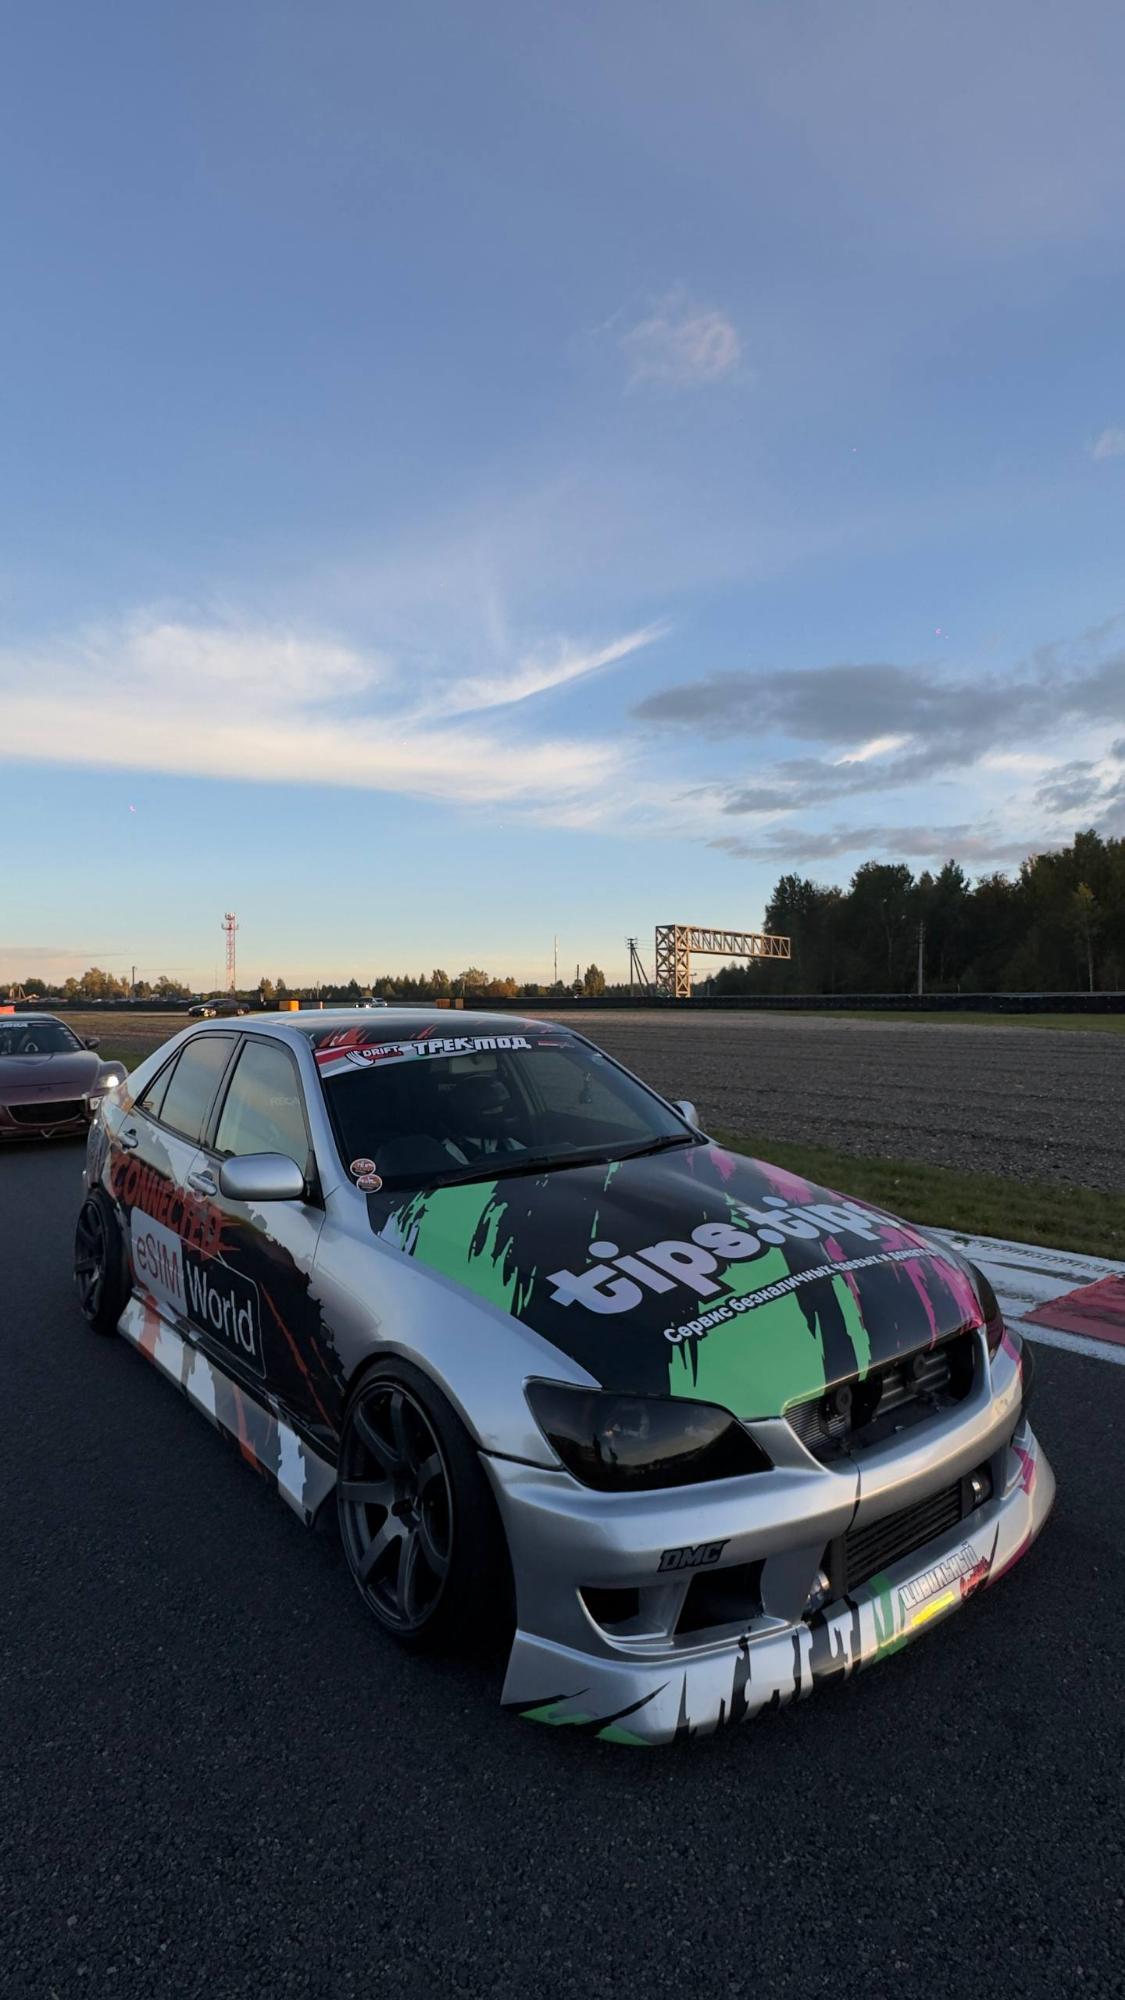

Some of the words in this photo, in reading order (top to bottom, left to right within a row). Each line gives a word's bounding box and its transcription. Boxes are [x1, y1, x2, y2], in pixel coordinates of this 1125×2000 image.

[362, 1045, 400, 1057] DRIFT
[136, 1232, 181, 1298] eSIM
[186, 1260, 256, 1356] World
[546, 1195, 899, 1315] tips.tips
[663, 1305, 734, 1343] Сервис
[729, 1263, 836, 1312] безналичных
[830, 1255, 884, 1271] чаевых
[657, 1539, 732, 1572] DMC
